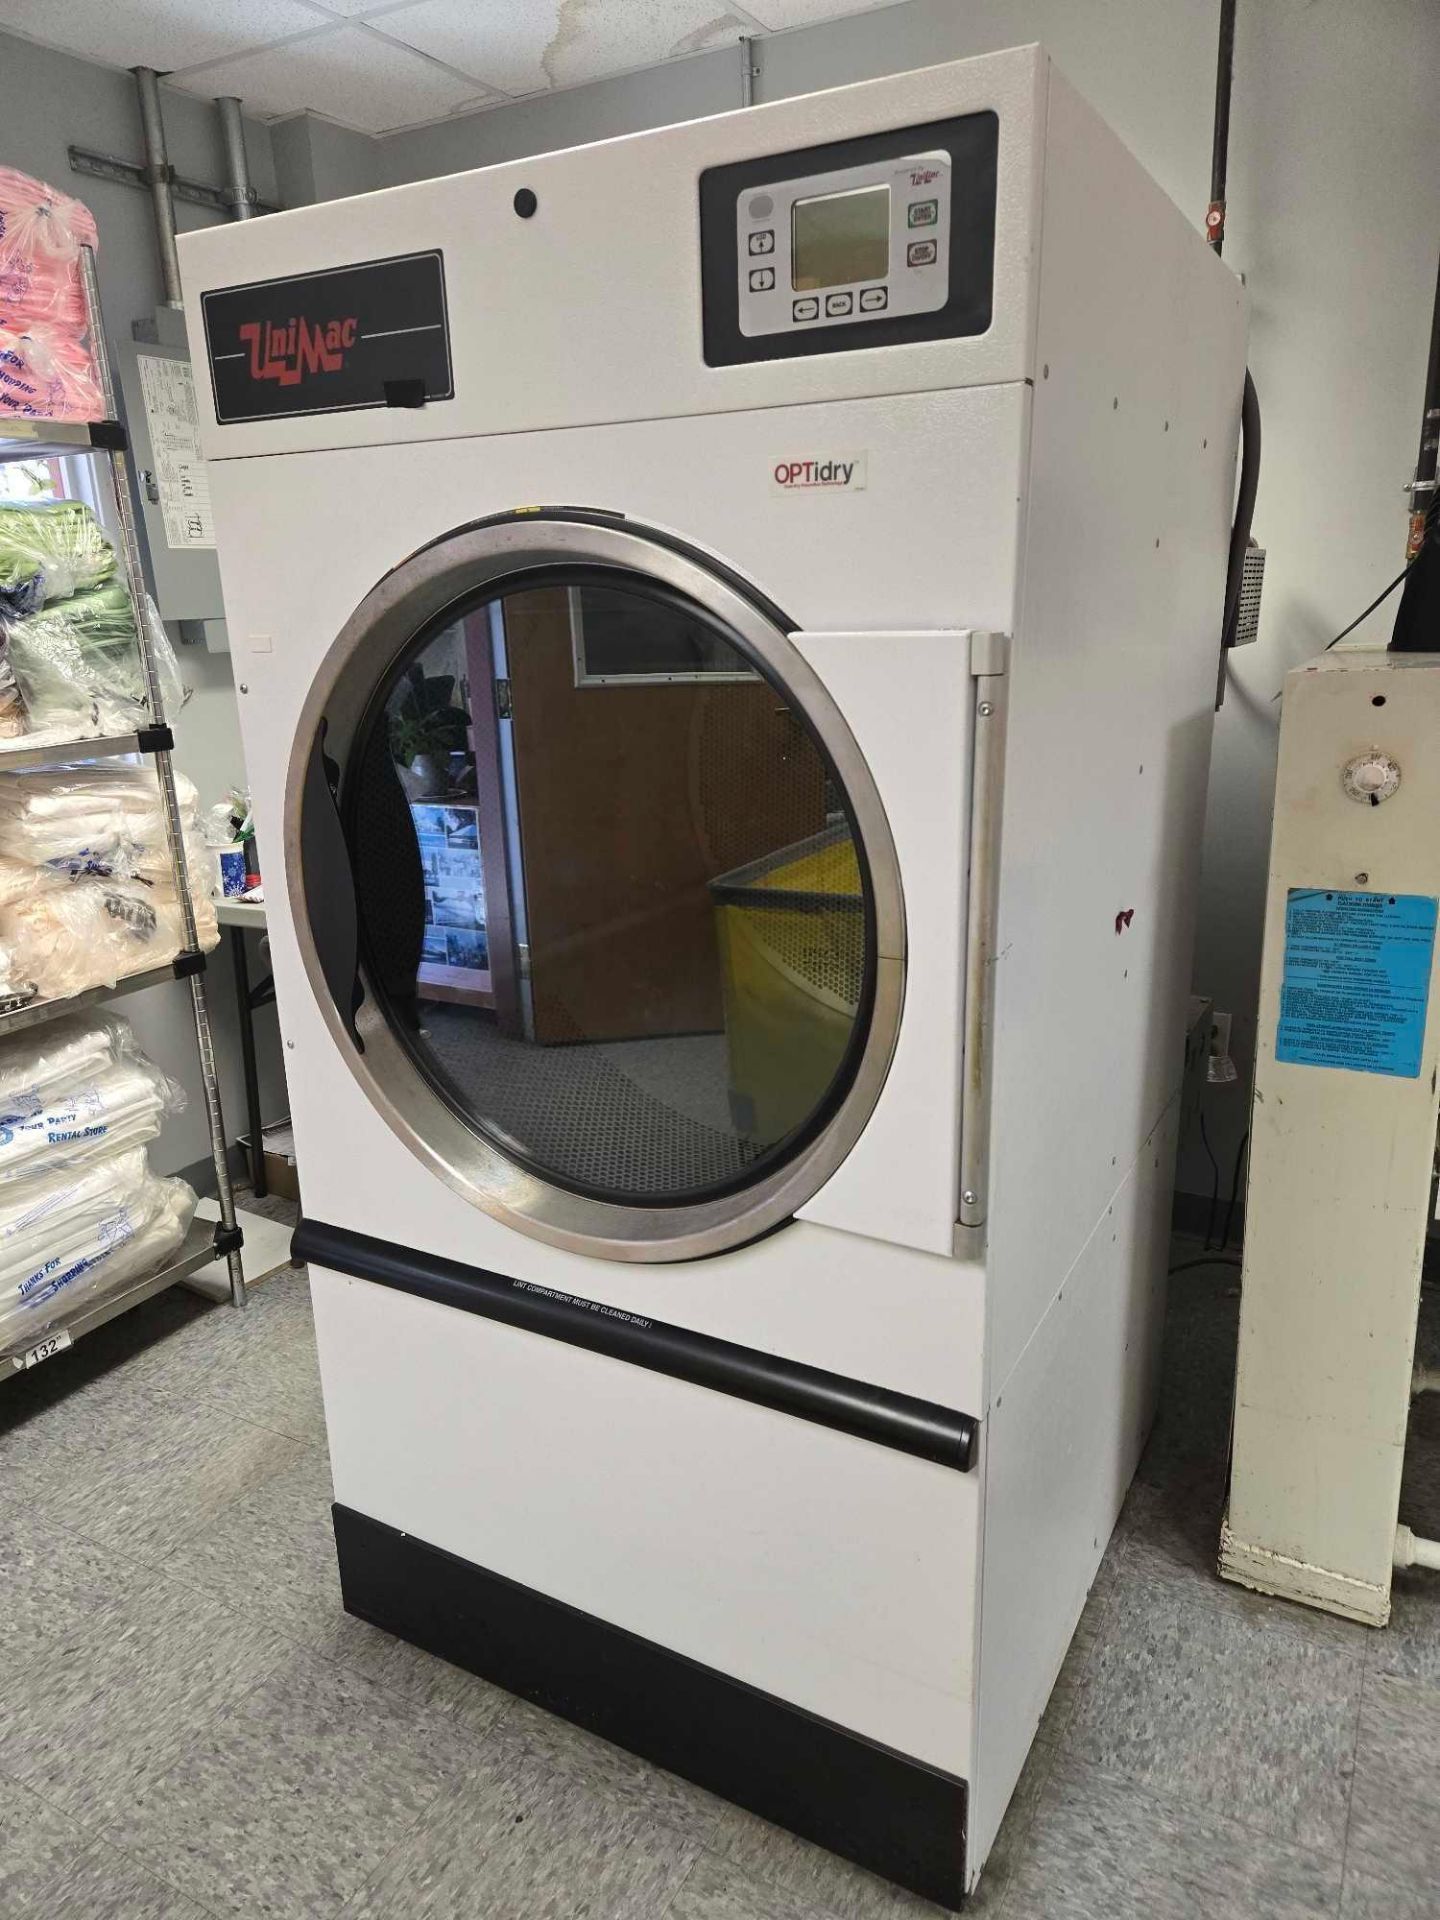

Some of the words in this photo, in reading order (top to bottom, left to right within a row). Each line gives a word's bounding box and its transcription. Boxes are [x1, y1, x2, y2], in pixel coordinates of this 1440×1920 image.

[239, 316, 358, 386] UniMac
[0, 370, 37, 394] HOPPING
[774, 460, 854, 485] OPTidry
[48, 1131, 81, 1143] RENTAL
[18, 1269, 44, 1295] THANKS
[45, 1257, 61, 1273] FOR
[513, 1280, 528, 1290] LINT
[527, 1284, 573, 1304] COMPARTMENT
[572, 1297, 592, 1309] MUST
[590, 1303, 601, 1312] BE
[600, 1306, 631, 1321] CLEANED
